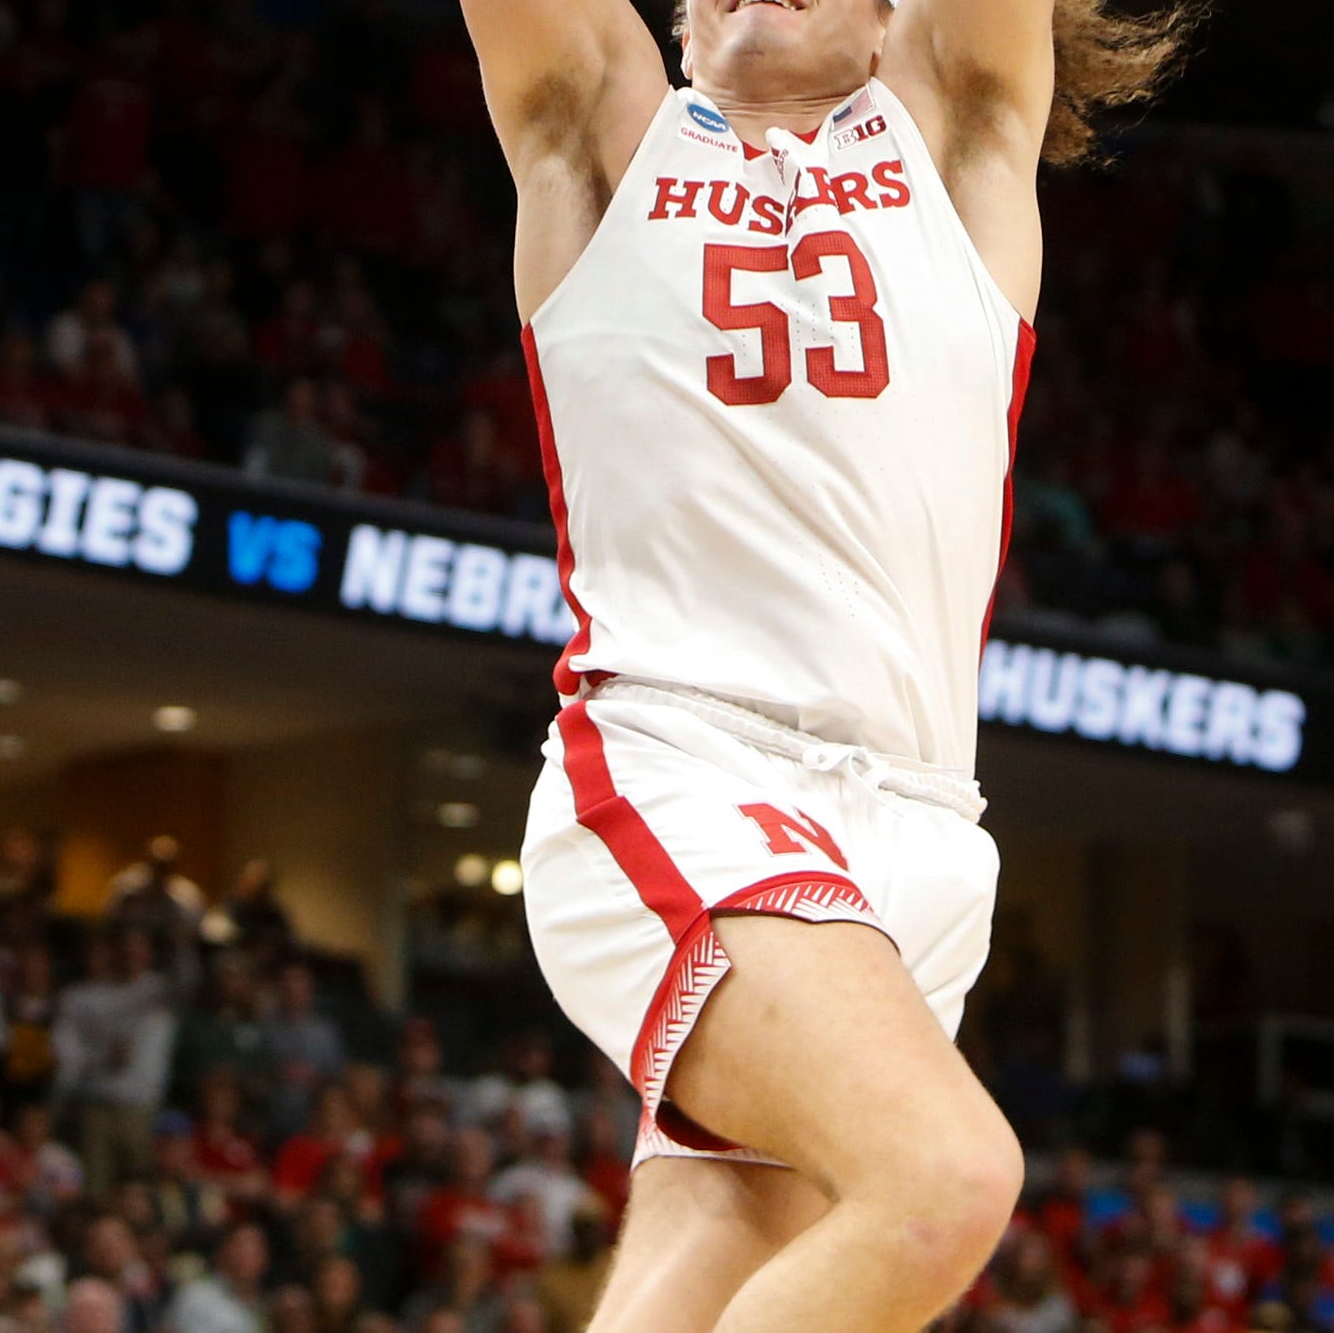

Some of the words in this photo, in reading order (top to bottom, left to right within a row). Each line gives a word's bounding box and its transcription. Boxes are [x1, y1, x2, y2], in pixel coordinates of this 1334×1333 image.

[680, 126, 738, 153] GRADUATE
[691, 109, 728, 131] NCAA
[647, 159, 911, 236] HUSRS
[701, 229, 891, 408] 53
[226, 510, 323, 594] VS
[339, 522, 573, 645] NEBR
[977, 637, 1307, 772] HUSKERS
[734, 801, 850, 873] N
